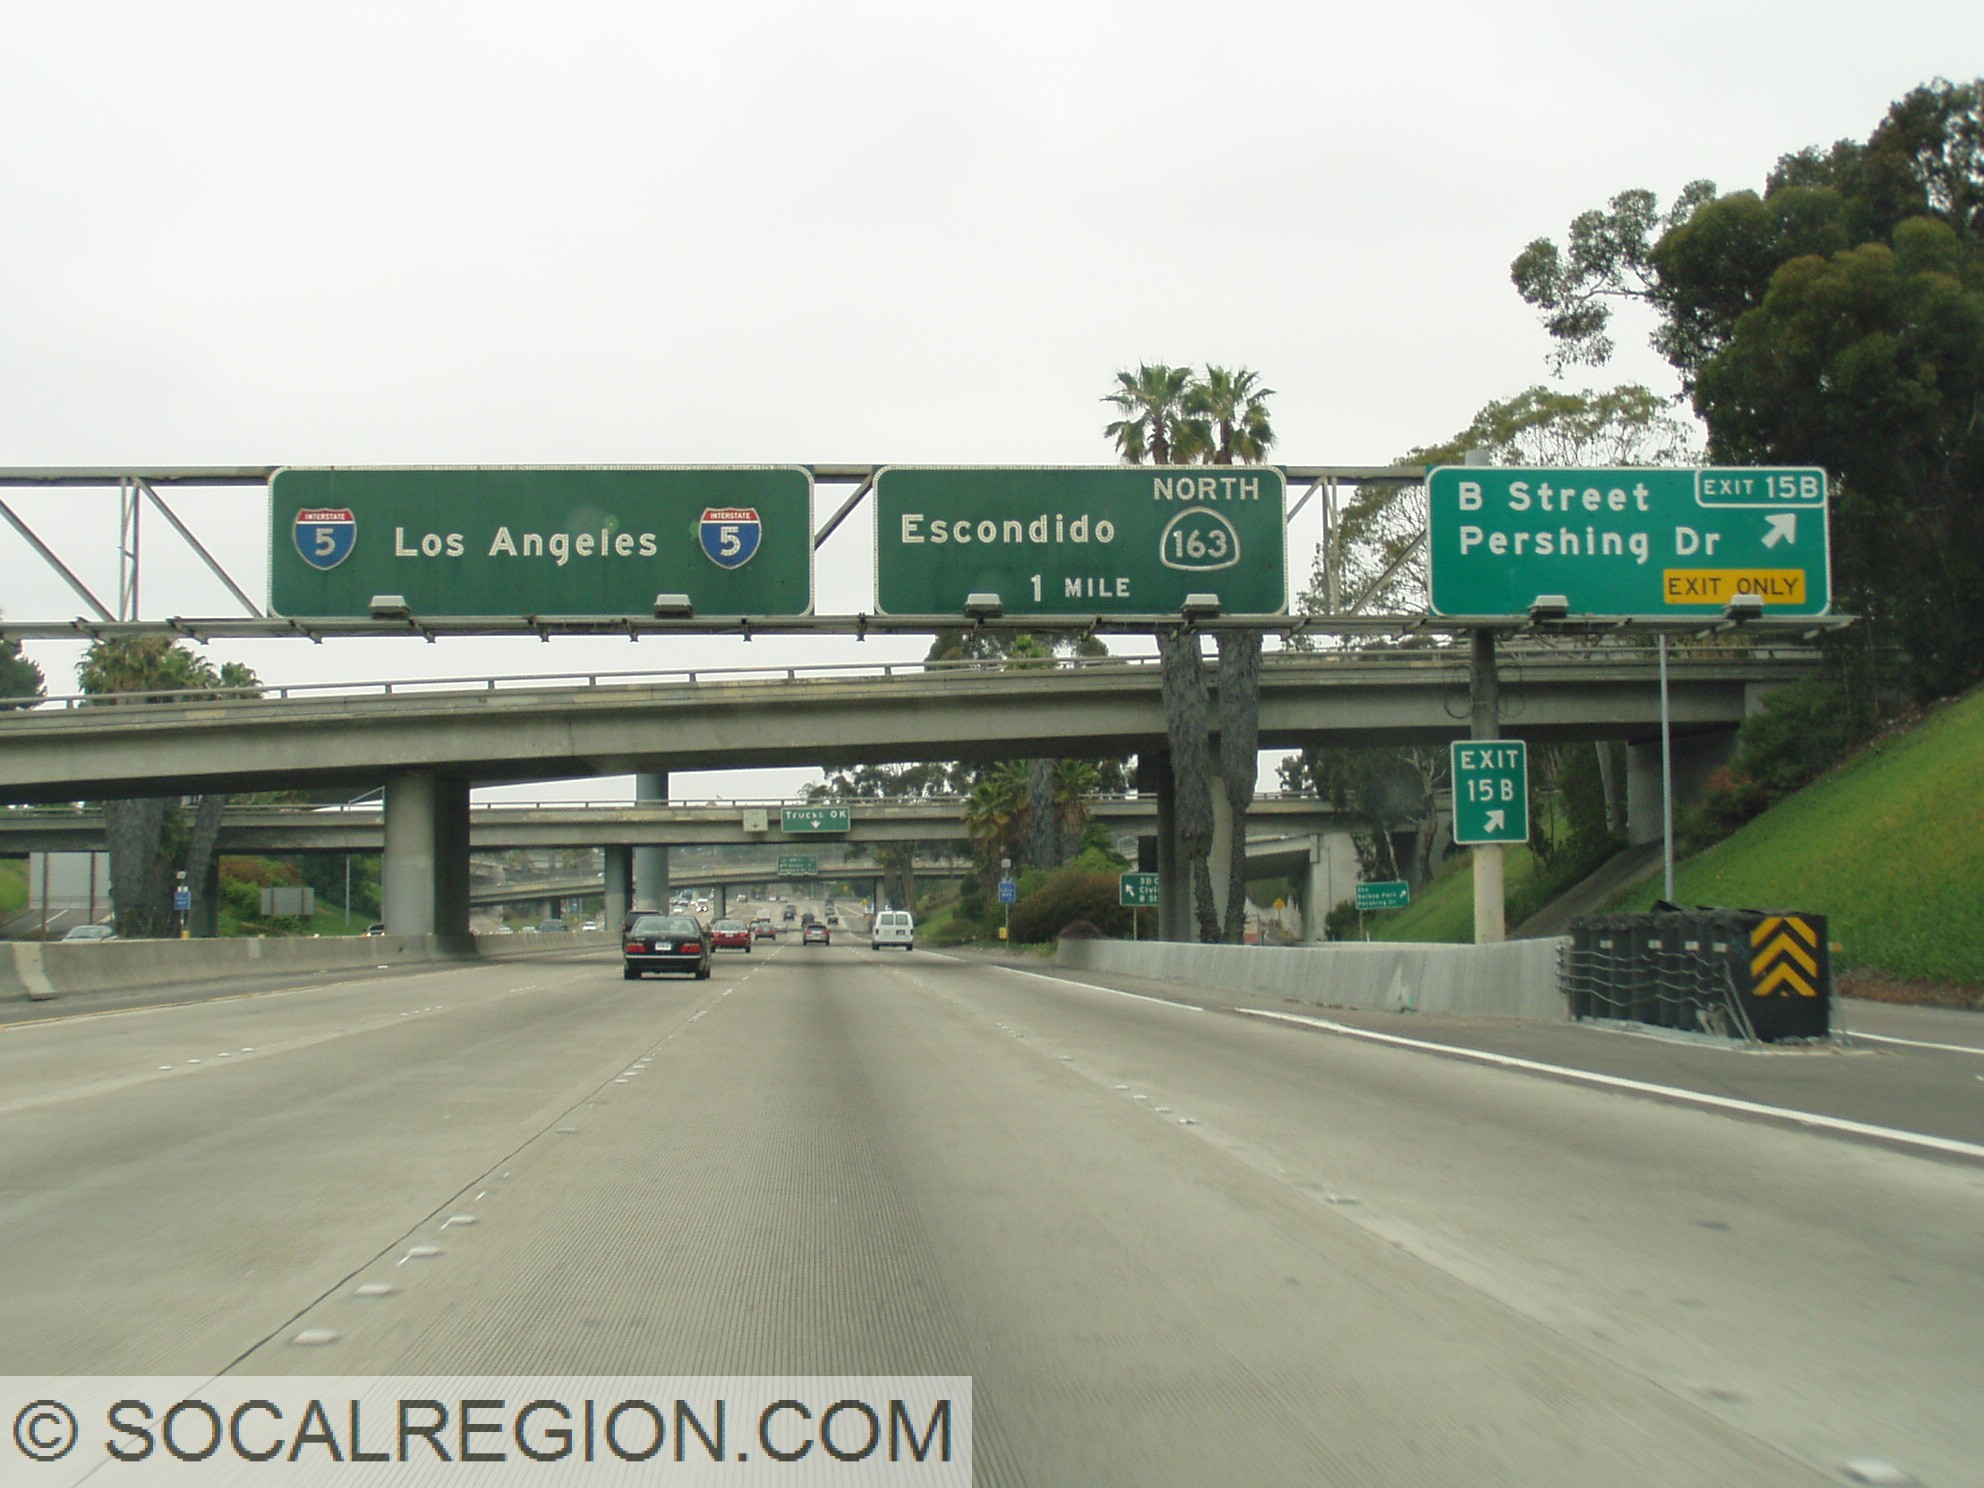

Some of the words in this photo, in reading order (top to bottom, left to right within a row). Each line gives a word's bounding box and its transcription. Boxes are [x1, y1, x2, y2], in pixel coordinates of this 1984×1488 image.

[1154, 477, 1259, 501] NORTH
[1458, 481, 1484, 511] B
[1508, 480, 1649, 512] Street
[1703, 479, 1754, 496] EXIT
[1766, 475, 1819, 499] 15B
[314, 527, 336, 557] 5
[720, 525, 741, 557] 5
[901, 513, 1115, 544] Escondido
[395, 526, 465, 557] Los
[488, 526, 658, 566] Angeles
[1172, 530, 1227, 558] 163
[1459, 525, 1649, 565] Pershing
[1675, 526, 1722, 556] Dr
[1030, 574, 1042, 602] 1
[1064, 577, 1131, 598] MILE
[1669, 577, 1721, 595] EXIT
[1737, 577, 1798, 595] ONLY
[1461, 749, 1519, 770] EXIT
[1467, 778, 1515, 802] 15B
[830, 810, 846, 819] OK
